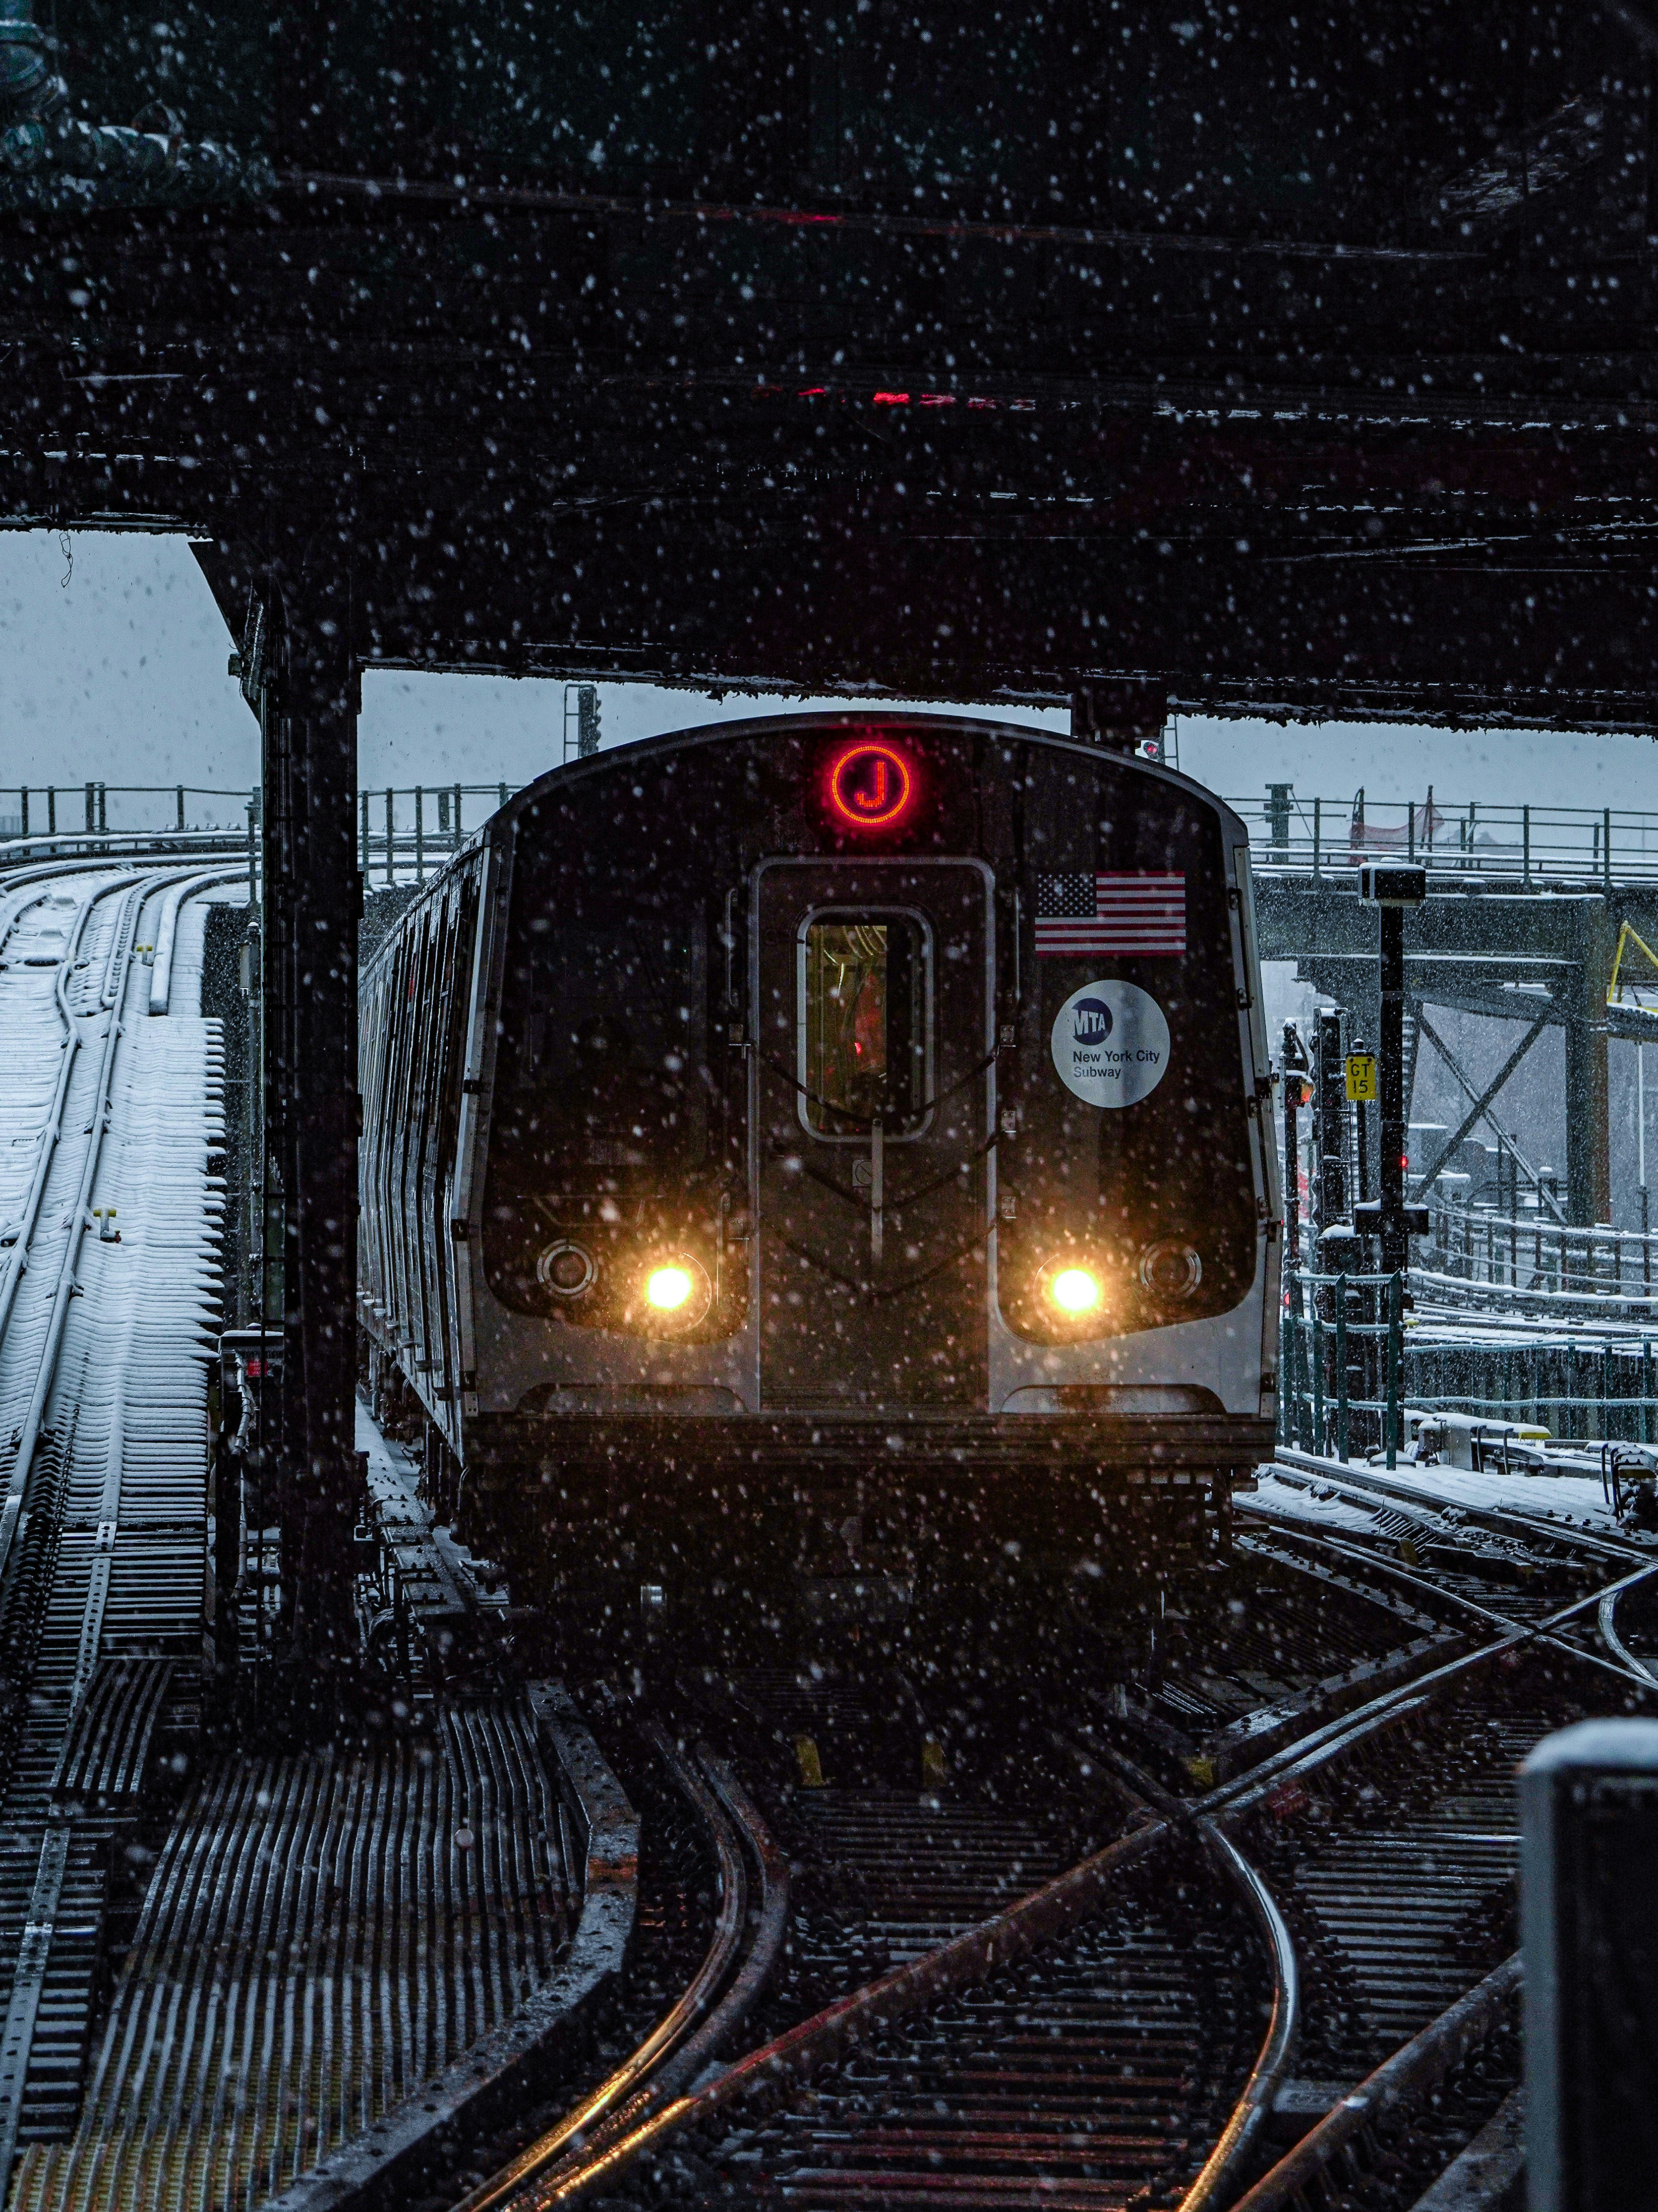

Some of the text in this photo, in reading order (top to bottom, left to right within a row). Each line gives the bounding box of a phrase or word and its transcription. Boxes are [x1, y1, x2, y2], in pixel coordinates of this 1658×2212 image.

[857, 761, 885, 807] J
[1071, 1008, 1106, 1036] MTA
[1073, 1050, 1160, 1064] New York City
[1073, 1066, 1121, 1079] Subway
[1351, 1064, 1370, 1077] GT
[1354, 1080, 1368, 1093] 15
